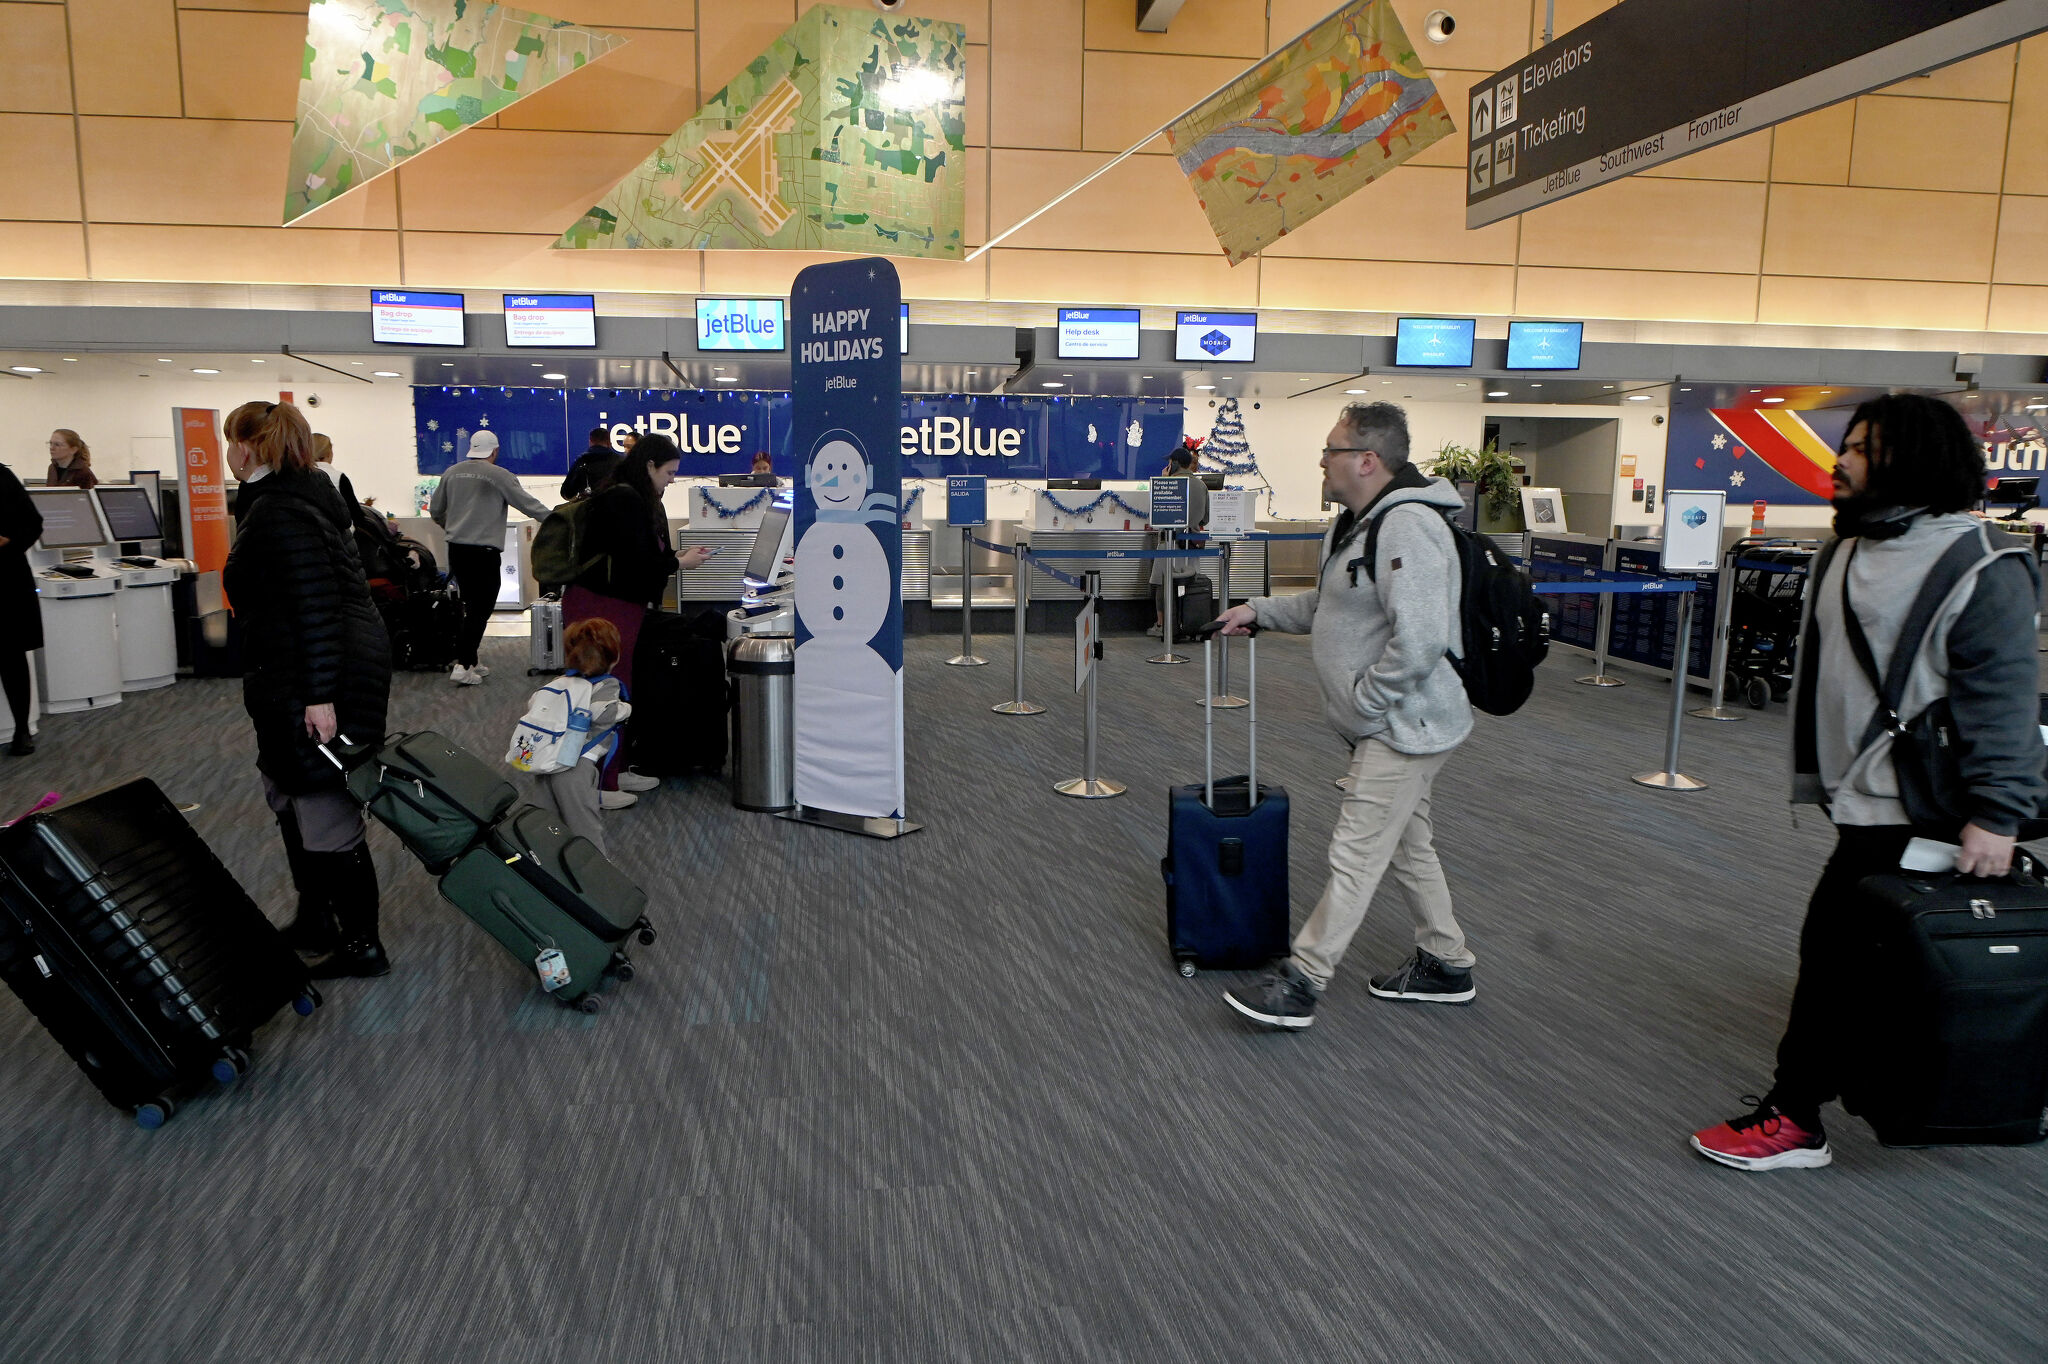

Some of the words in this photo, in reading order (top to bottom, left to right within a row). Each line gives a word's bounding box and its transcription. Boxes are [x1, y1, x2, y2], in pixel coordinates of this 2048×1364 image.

[1523, 41, 1592, 94] Elevators
[1521, 105, 1586, 150] Ticketing
[1543, 168, 1581, 194] JetBlue
[1600, 135, 1665, 172] Southwest
[1688, 107, 1742, 142] Frontier
[379, 293, 406, 302] jetBlue
[512, 297, 538, 307] jetBlue
[705, 313, 774, 338] jetBlue
[812, 309, 870, 334] HAPPY
[1065, 311, 1089, 320] jetBlue
[1184, 314, 1207, 323] jetBlue
[801, 337, 883, 364] HOLIDAYS
[825, 376, 857, 392] jetBlue
[901, 416, 1021, 457] etBlue
[191, 475, 208, 483] BAG
